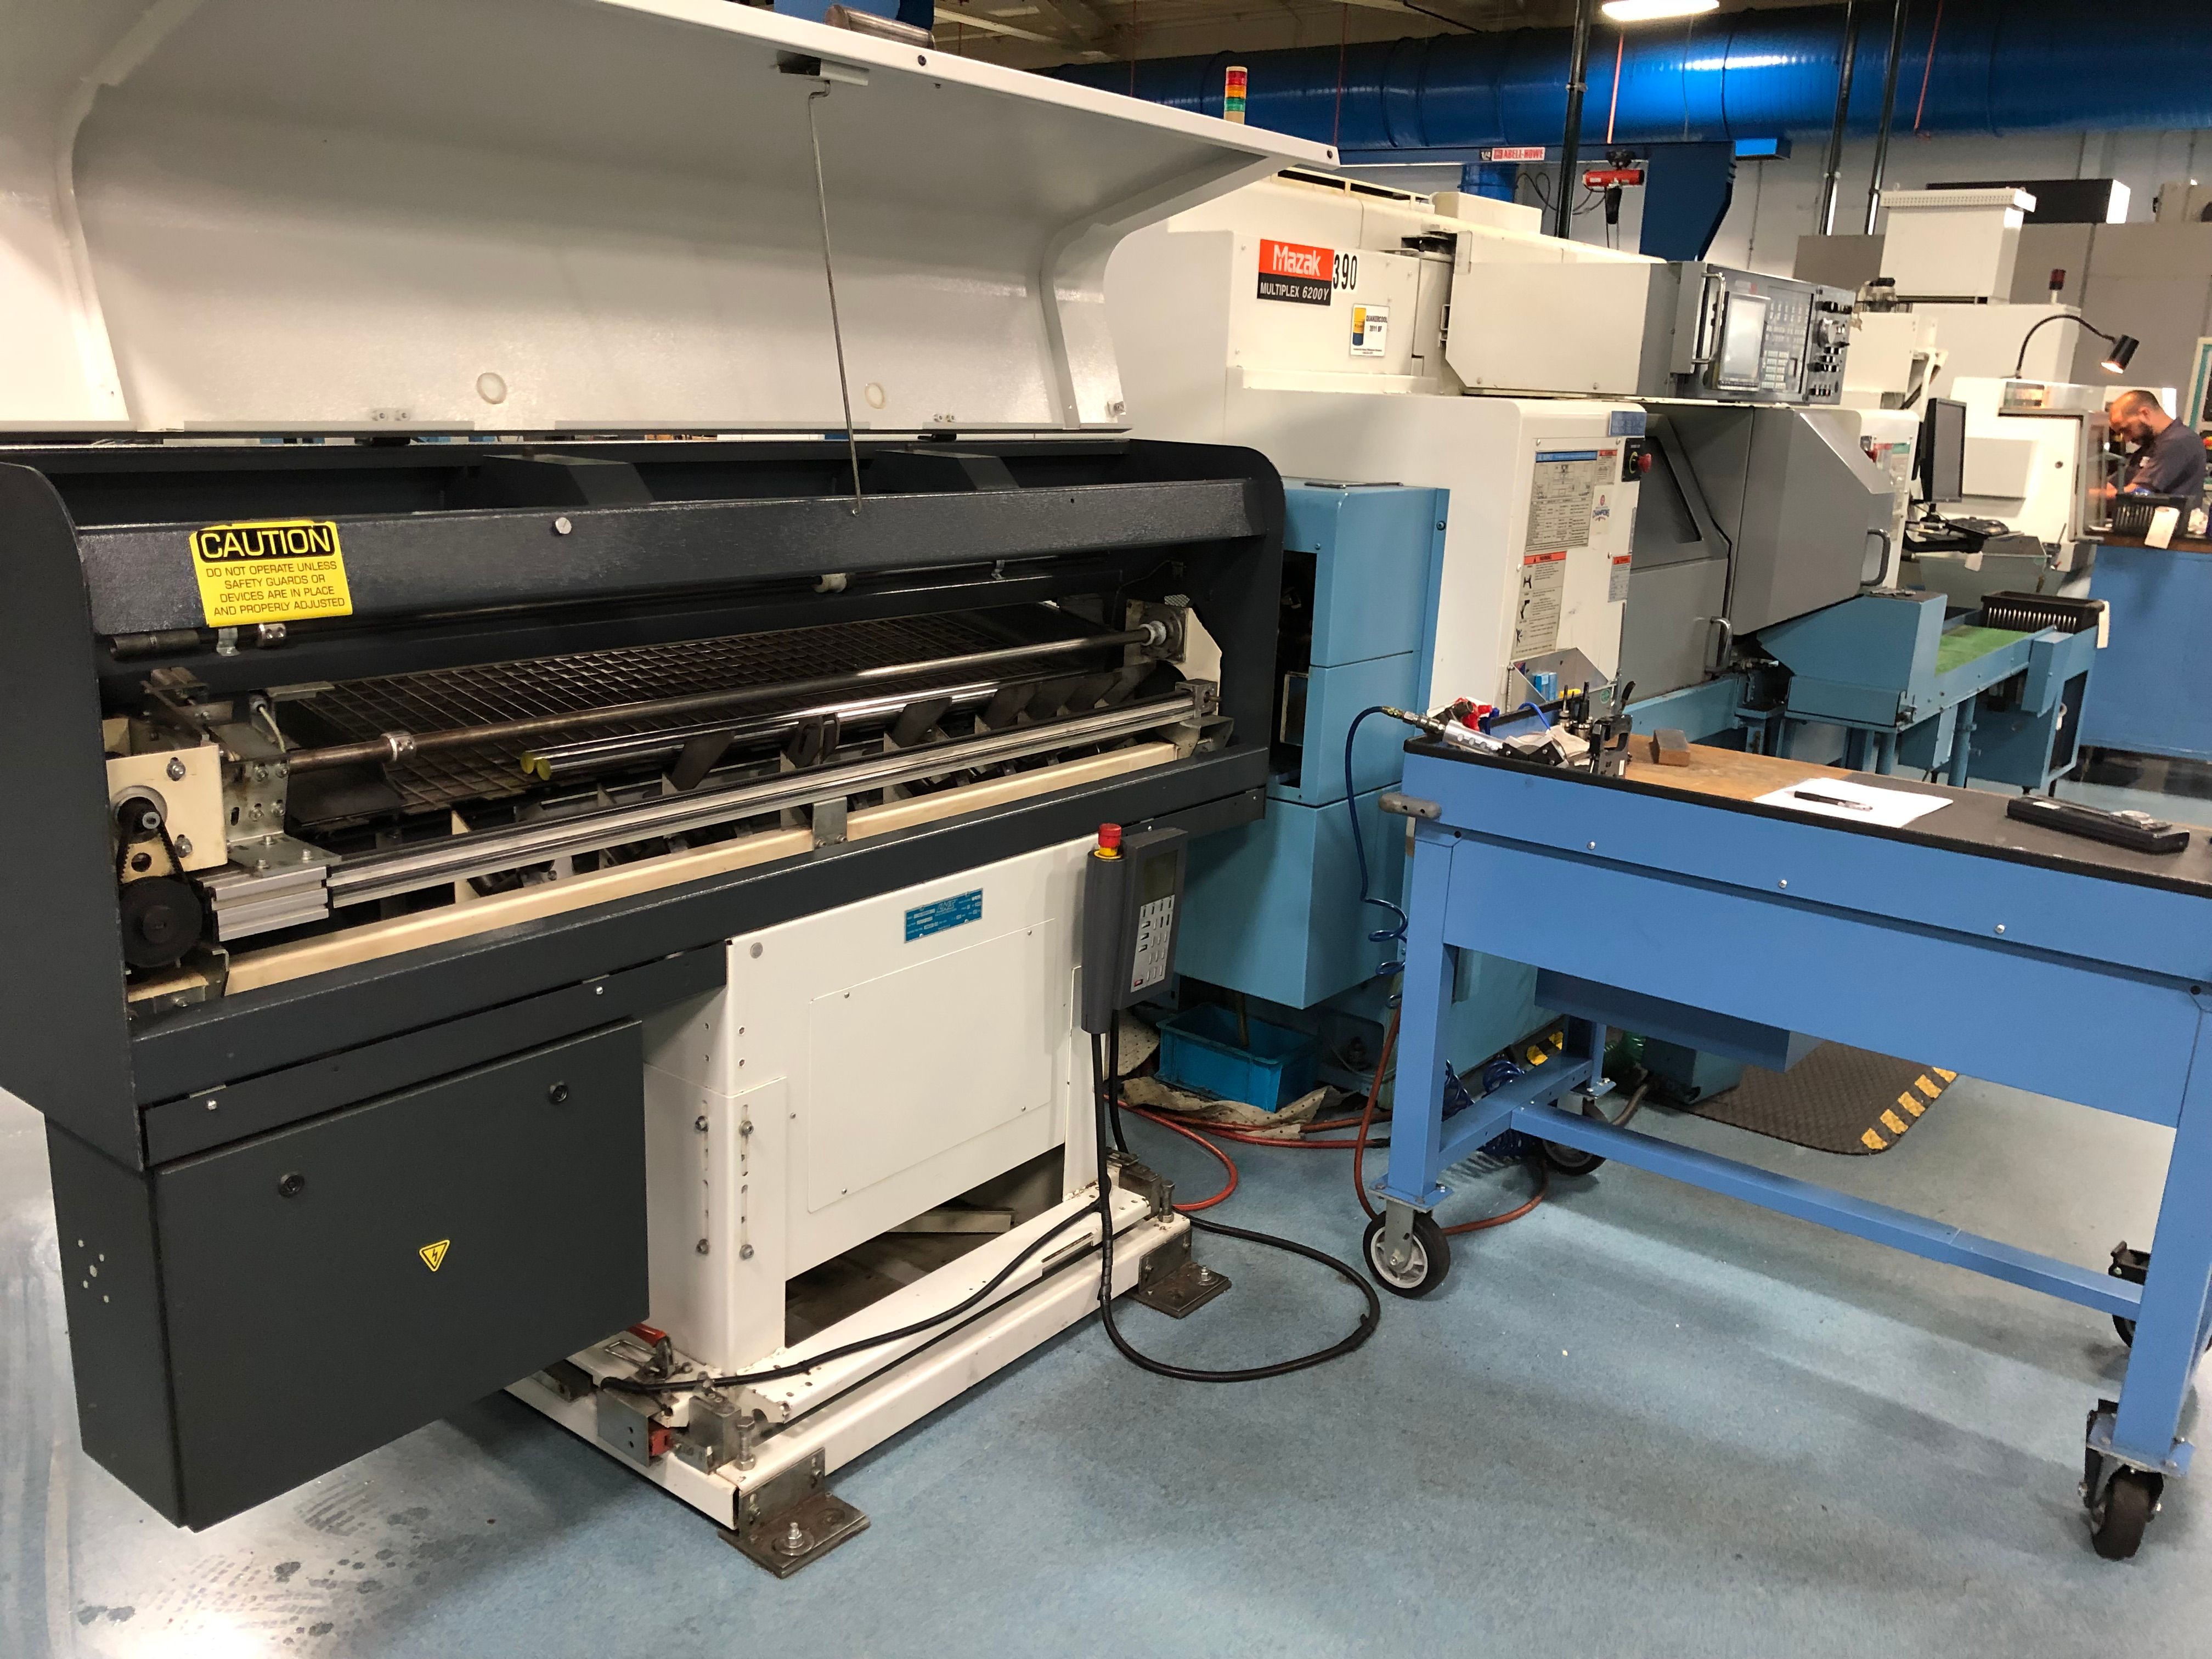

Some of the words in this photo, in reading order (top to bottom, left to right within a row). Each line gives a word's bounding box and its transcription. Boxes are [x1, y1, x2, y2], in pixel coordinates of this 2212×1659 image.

[1273, 245, 1321, 276] Mazak
[1333, 253, 1358, 290] 390
[1260, 282, 1300, 298] MULTIPLEX
[1302, 286, 1329, 301] 6200Y
[201, 528, 331, 558] CAUTION
[206, 568, 222, 578] DO
[225, 567, 245, 576] NOT
[250, 563, 294, 575] OPERATE
[298, 561, 337, 572] UNLESS
[225, 578, 263, 589] SAFETY
[266, 575, 308, 586] GUARDS
[312, 574, 325, 583] OR
[220, 591, 264, 602] DEVICES
[268, 590, 287, 599] ARE
[291, 589, 301, 597] IN
[304, 586, 335, 597] PLACE
[214, 606, 236, 616] AND
[240, 602, 290, 614] PROPERLY
[294, 598, 345, 610] ADJUSTED
